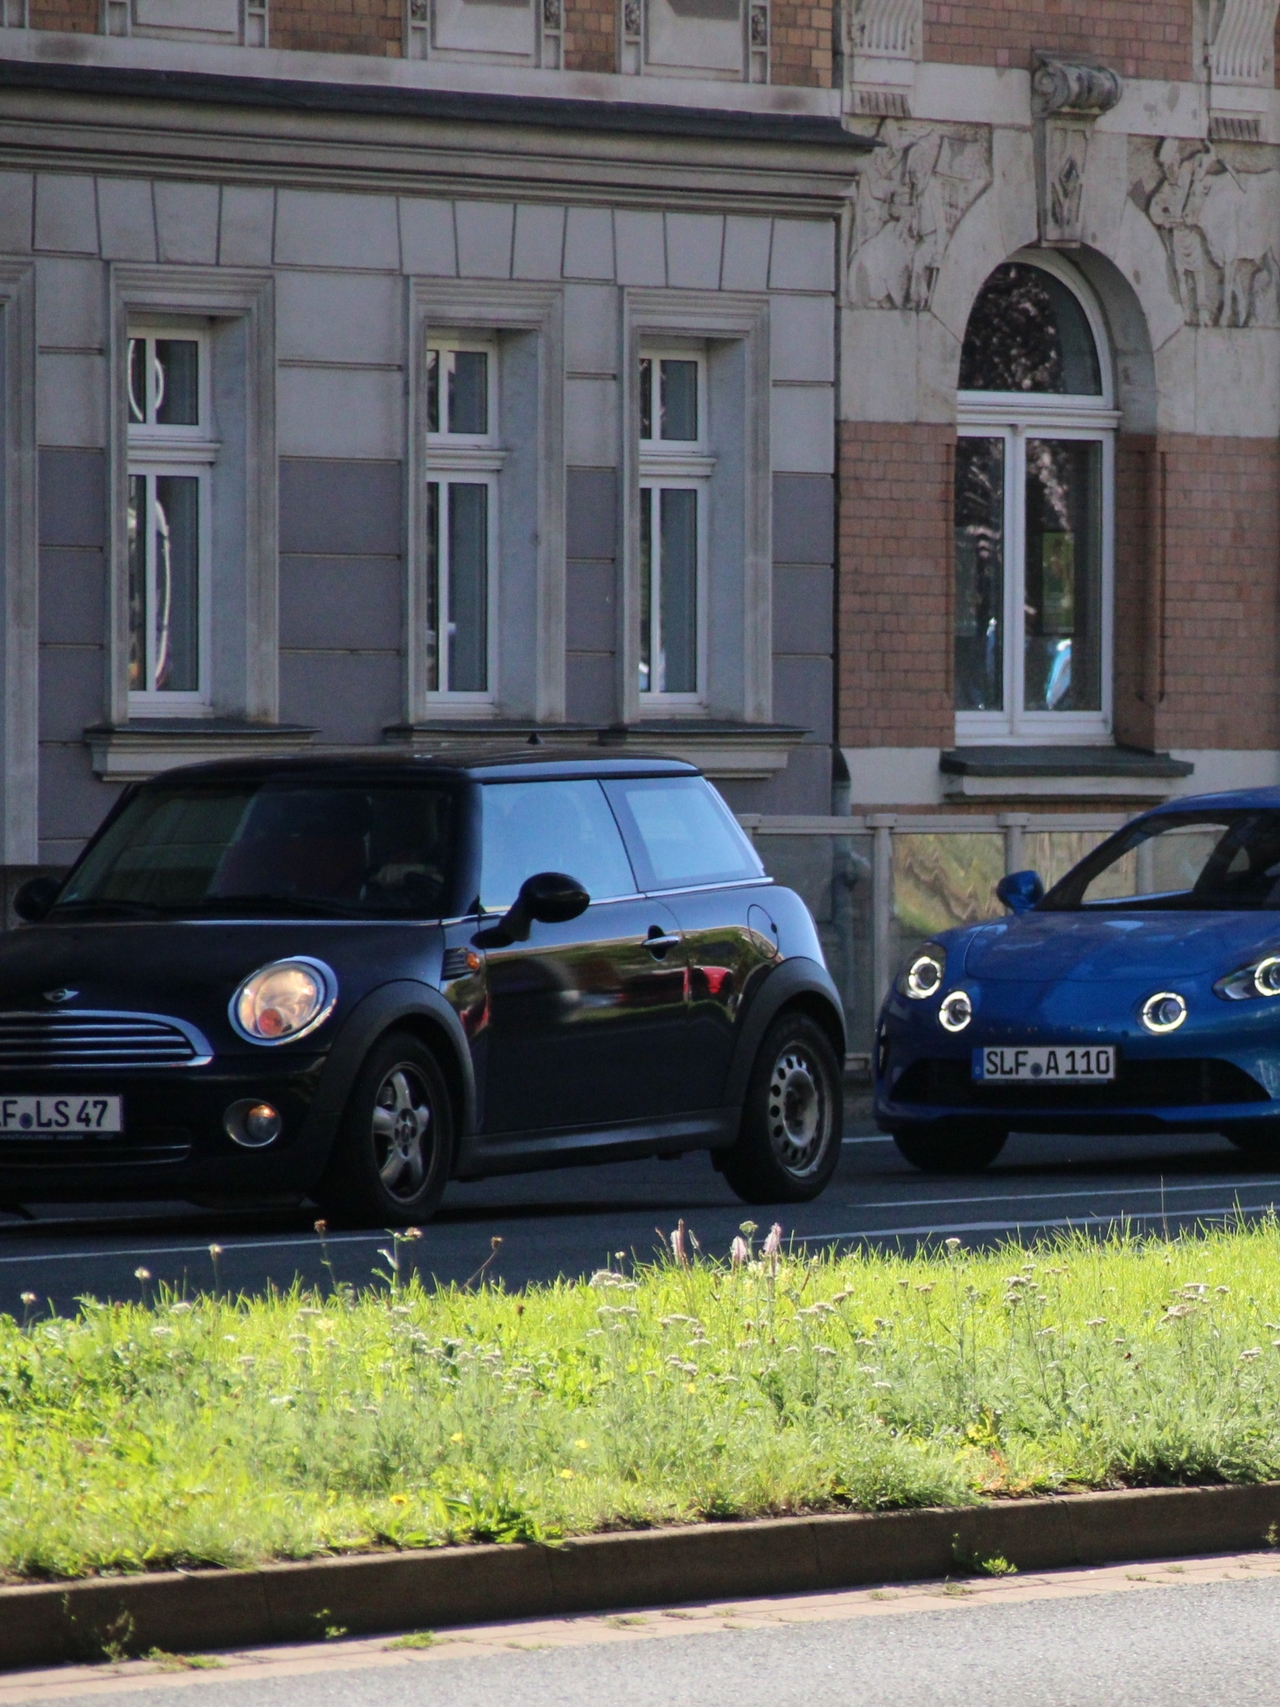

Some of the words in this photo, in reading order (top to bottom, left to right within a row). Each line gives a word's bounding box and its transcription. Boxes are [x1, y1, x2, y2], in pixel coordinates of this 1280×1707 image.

[986, 1051, 1028, 1075] SLF
[1045, 1051, 1059, 1075] A
[1065, 1051, 1110, 1075] 110
[36, 1101, 70, 1127] LS
[76, 1100, 108, 1127] 47
